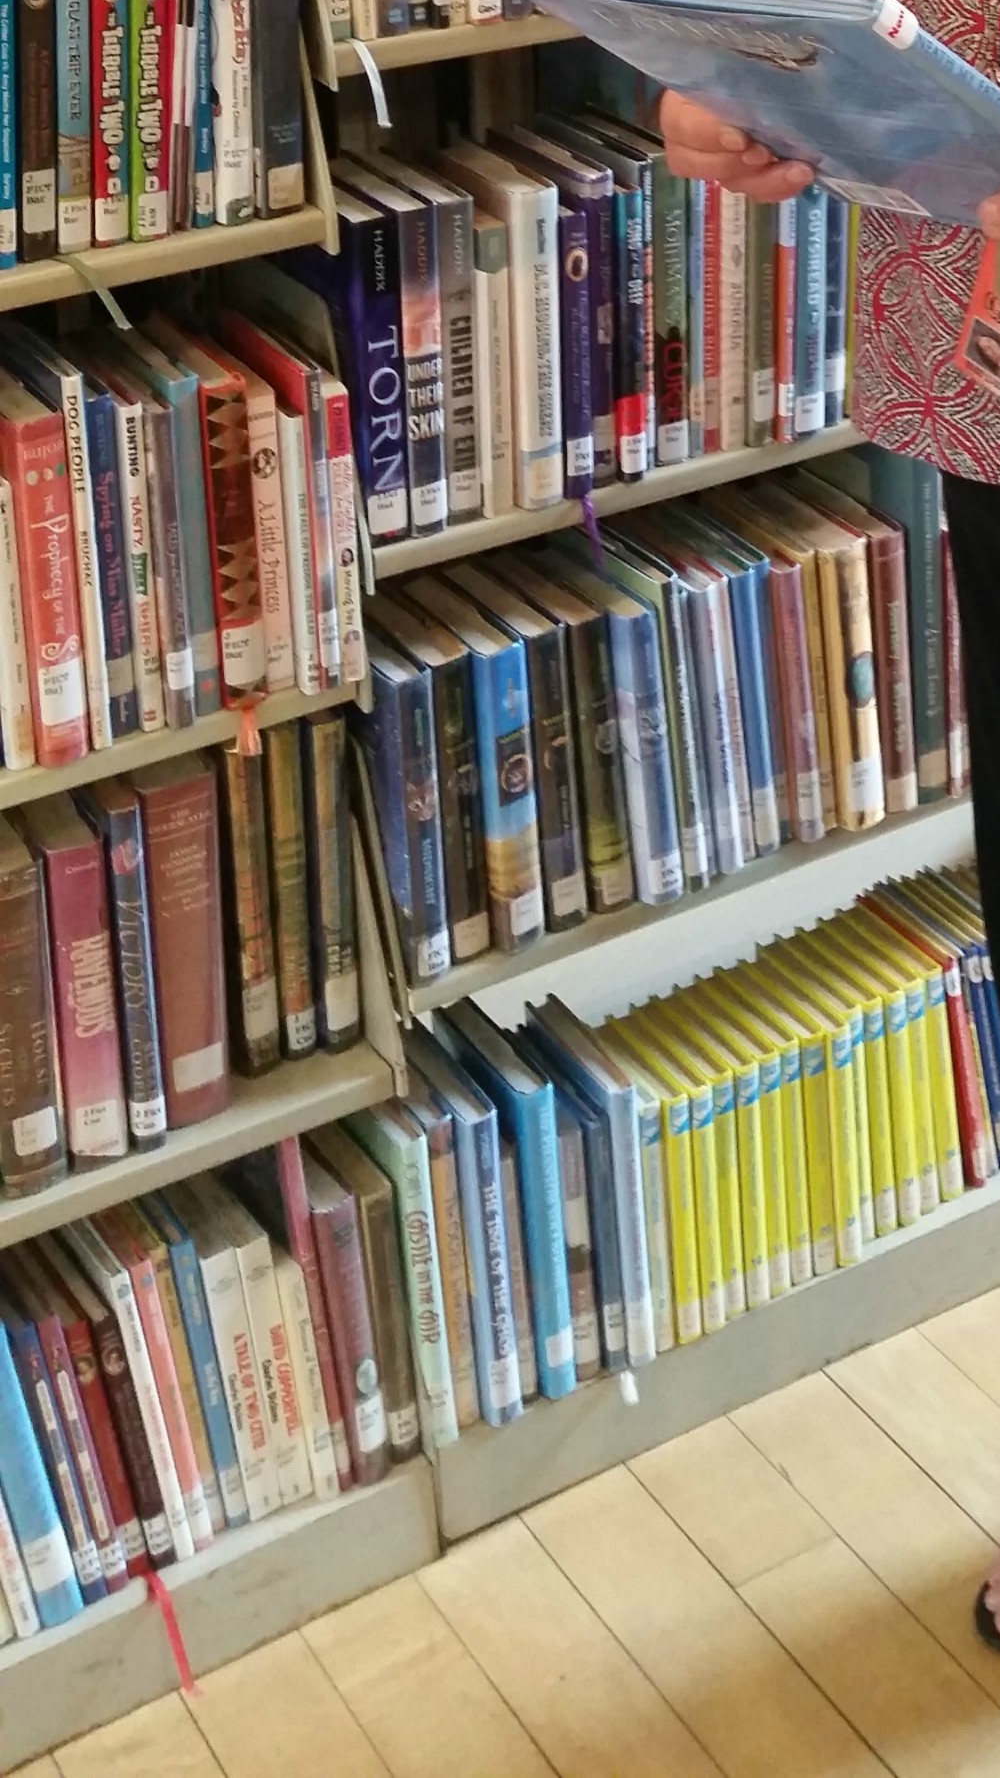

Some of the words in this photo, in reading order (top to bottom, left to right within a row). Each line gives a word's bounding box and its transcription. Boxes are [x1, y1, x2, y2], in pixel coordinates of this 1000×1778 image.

[68, 46, 82, 76] TRIP
[69, 82, 83, 120] EVER
[99, 101, 124, 144] TWO
[137, 99, 162, 143] TWO
[407, 357, 443, 385] UNDER
[66, 394, 79, 430] DOG
[366, 324, 406, 491] TORN
[408, 382, 444, 409] THEIR
[408, 406, 445, 441] SKIN
[70, 435, 85, 494] PEOPLE
[125, 415, 140, 478] BUNTING
[31, 513, 71, 600] Prophecy
[262, 558, 282, 616] Princess
[116, 900, 147, 1016] VICTORY
